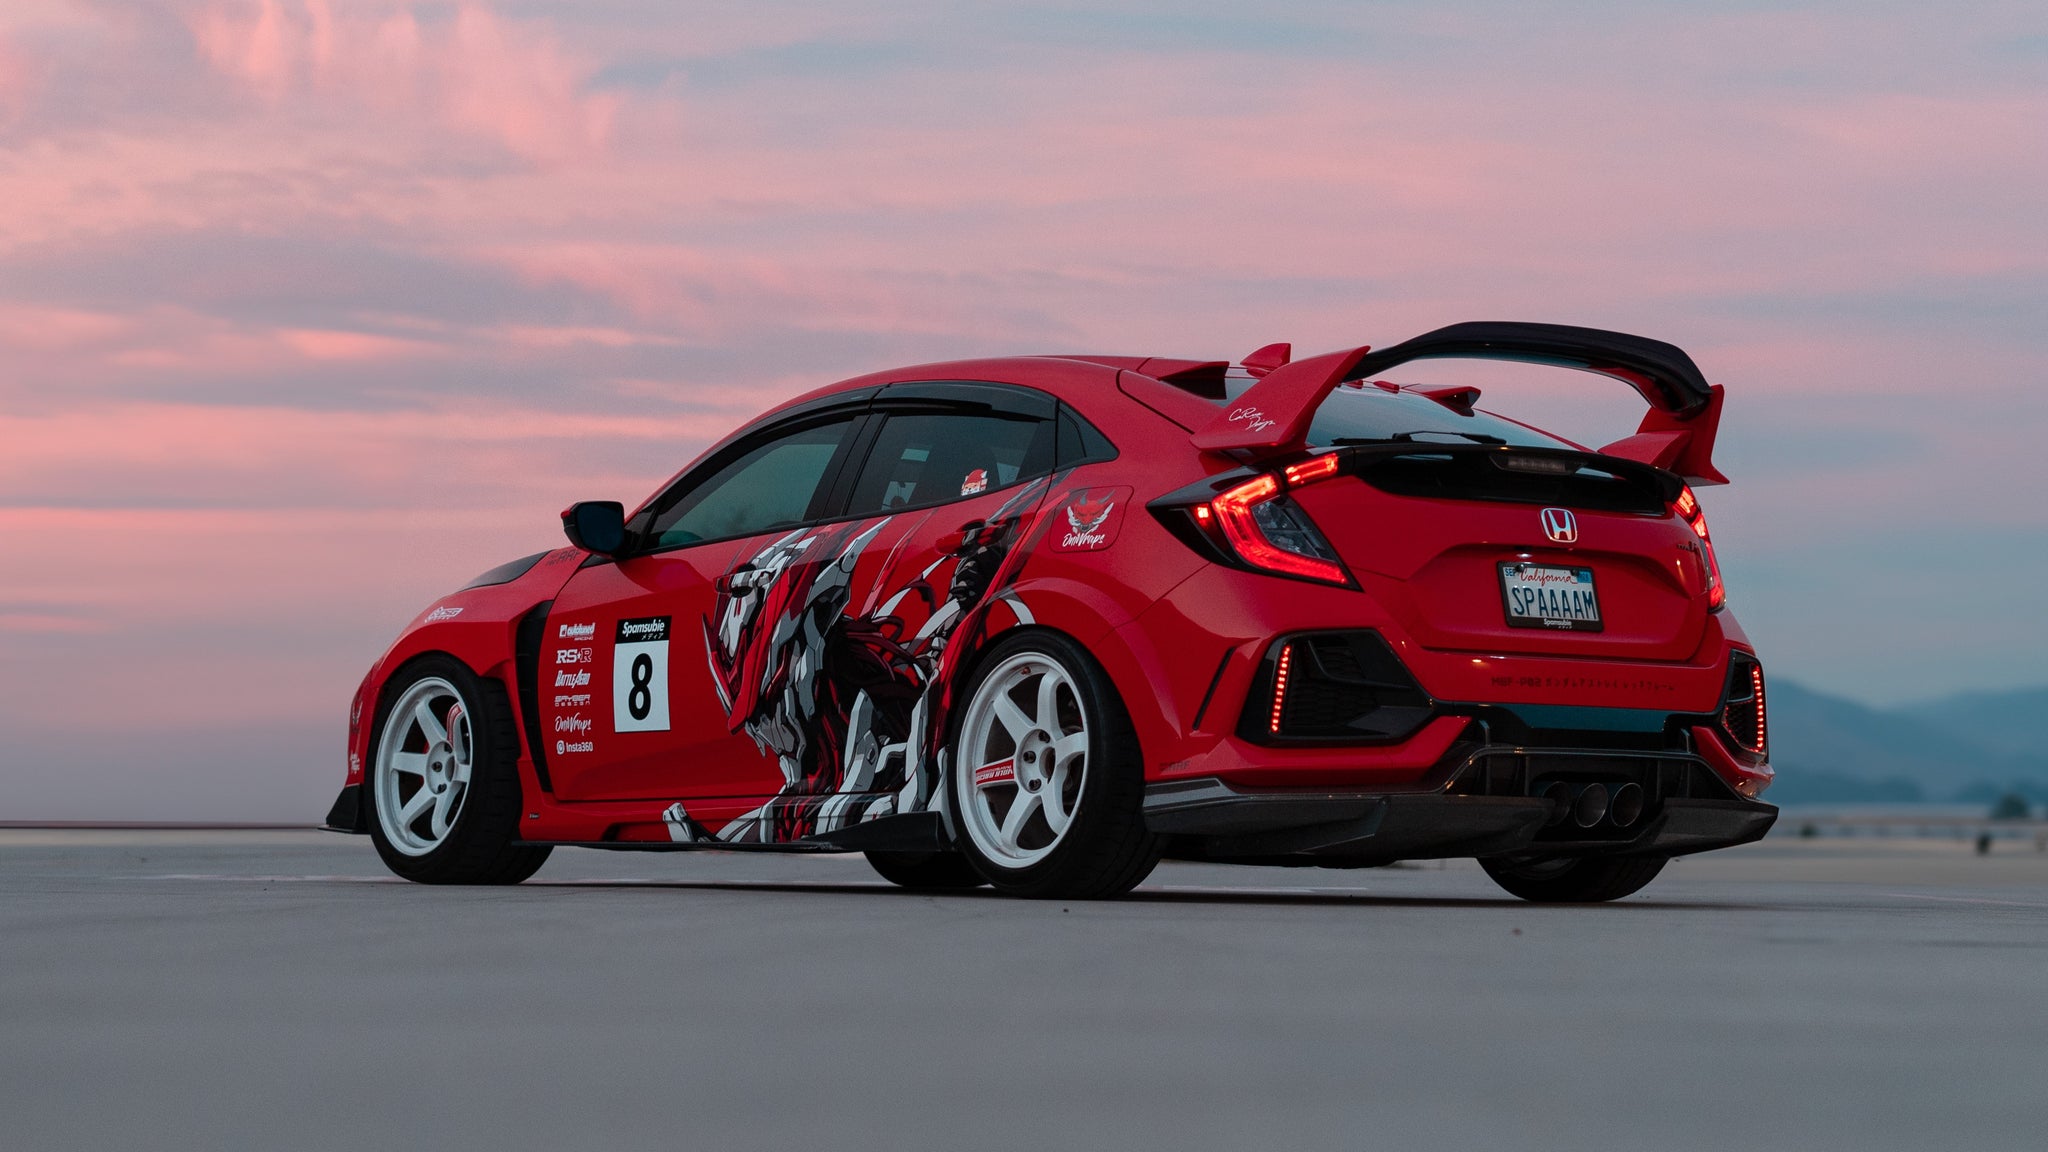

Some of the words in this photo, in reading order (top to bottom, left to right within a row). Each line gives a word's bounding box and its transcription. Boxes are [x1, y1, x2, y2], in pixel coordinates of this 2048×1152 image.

[1520, 567, 1578, 586] California
[1511, 586, 1597, 619] SPAAAAM
[622, 618, 665, 637] Spamsubie
[628, 653, 653, 721] 8
[566, 741, 593, 752] Insta360
